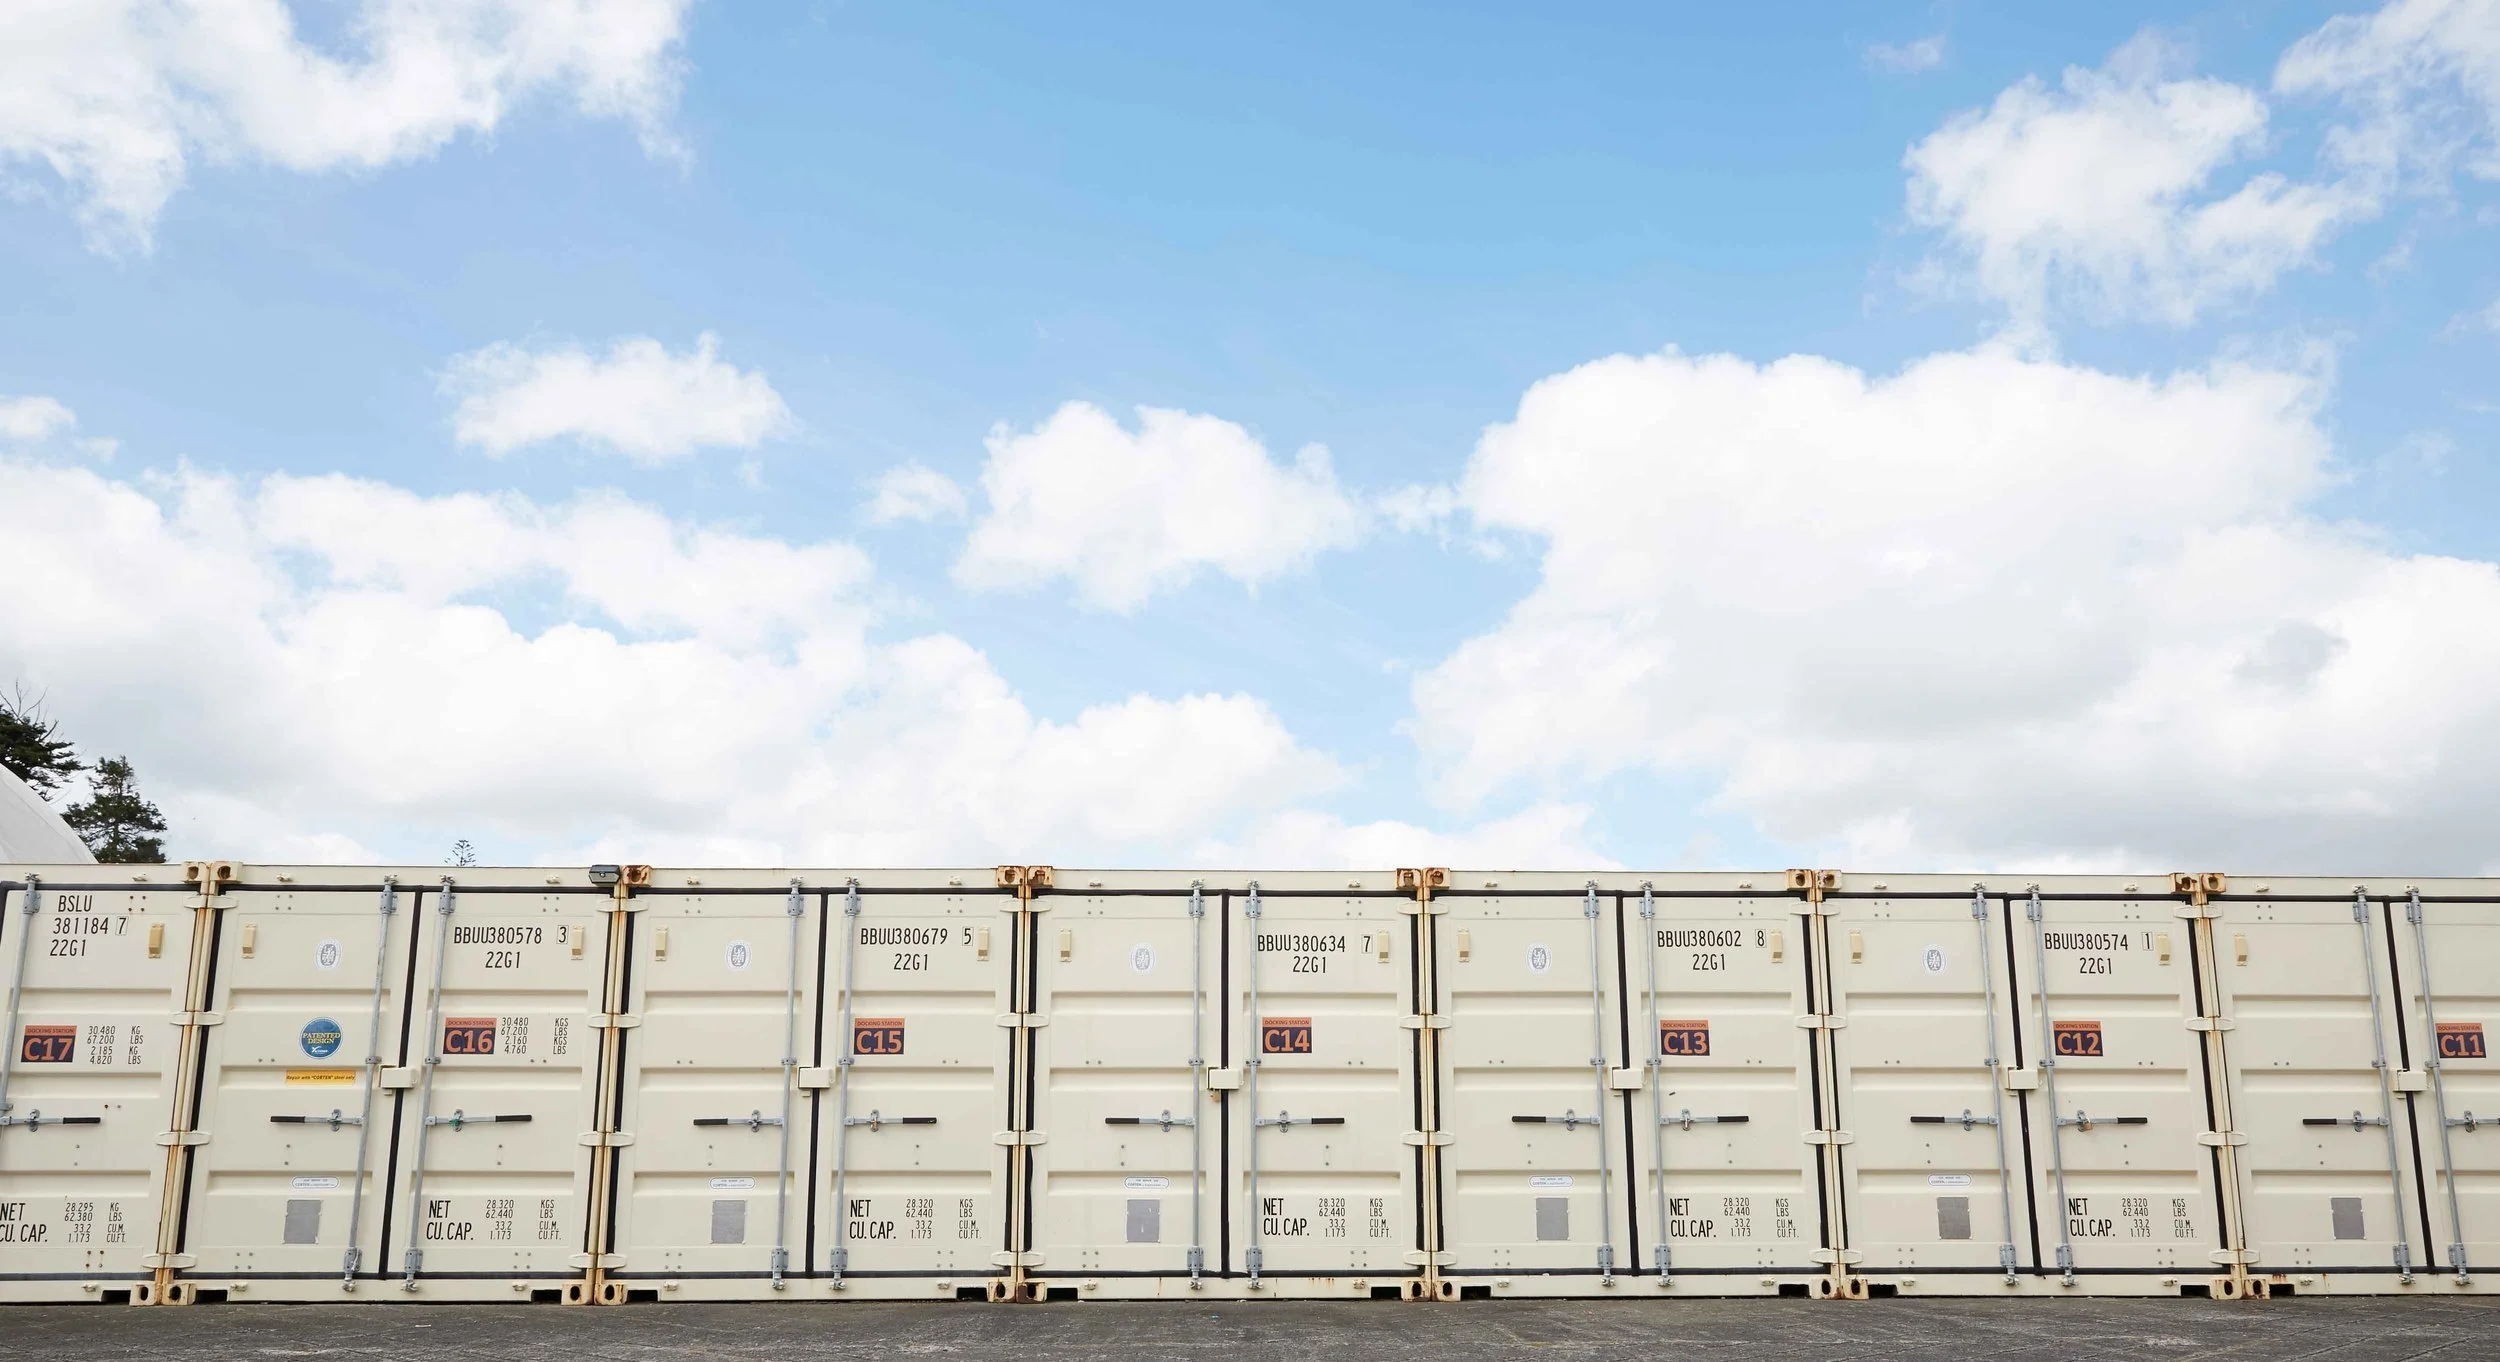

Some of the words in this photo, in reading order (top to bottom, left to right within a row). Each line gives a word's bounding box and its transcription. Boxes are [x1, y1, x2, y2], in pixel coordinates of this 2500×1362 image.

[58, 895, 92, 912] BSLU
[53, 917, 108, 934] 381184
[119, 917, 127, 934] 7
[454, 926, 542, 944] BBUU380578
[559, 927, 567, 943] 3
[860, 928, 948, 945] BBUU380679
[964, 928, 971, 944] 5
[1657, 930, 1742, 947] BBUU380602
[1757, 930, 1765, 947] 8
[50, 939, 86, 956] 22G1
[1257, 935, 1345, 952] BBUU380634
[1364, 935, 1371, 952] 7
[2044, 933, 2128, 951] BBUU380574
[2145, 933, 2150, 949] 1
[485, 951, 520, 968] 22G1
[894, 953, 928, 971] 22G1
[1293, 956, 1326, 973] 22G1
[1693, 954, 1725, 972] 22G1
[2080, 957, 2111, 974] 22G1
[502, 1017, 528, 1026] 30.480
[555, 1018, 568, 1027] KGS
[88, 1026, 115, 1035] 30.480
[131, 1026, 140, 1035] KG
[501, 1026, 528, 1035] 67.200
[554, 1027, 567, 1036] LBS
[87, 1035, 114, 1044] 67.200
[130, 1035, 143, 1044] LBS
[446, 1030, 492, 1053] C16
[505, 1036, 527, 1045] 2.160
[554, 1036, 567, 1045] KGS
[856, 1030, 902, 1053] C15
[1265, 1029, 1310, 1052] C14
[1663, 1032, 1707, 1054] C13
[2058, 1032, 2100, 1054] C12
[2440, 1034, 2483, 1056] C11
[24, 1038, 74, 1061] C17
[91, 1046, 112, 1055] 2.185
[129, 1046, 138, 1055] KG
[504, 1045, 526, 1054] 4.760
[553, 1046, 566, 1054] LBS
[90, 1056, 112, 1064] 4.820
[128, 1056, 141, 1064] LBS
[65, 1202, 93, 1212] 28.295
[110, 1202, 119, 1212] KG
[486, 1199, 514, 1209] 28.320
[541, 1199, 554, 1209] KGS
[850, 1200, 871, 1217] NET
[906, 1199, 933, 1208] 28.320
[960, 1199, 973, 1208] KGS
[1263, 1198, 1284, 1216] NET
[1319, 1198, 1345, 1207] 28.320
[1370, 1198, 1383, 1207] KGS
[1670, 1198, 1689, 1216] NET
[1724, 1197, 1749, 1206] 28.320
[1776, 1198, 1789, 1207] KGS
[2068, 1198, 2088, 1216] NET
[2122, 1198, 2147, 1208] 28.320
[2172, 1198, 2185, 1207] KGS
[0, 1203, 26, 1221] NET
[428, 1200, 451, 1218] NET
[486, 1209, 513, 1218] 62.440
[540, 1209, 553, 1218] LBS
[905, 1208, 933, 1218] 62.440
[960, 1208, 972, 1218] LBS
[1318, 1208, 1345, 1217] 62.440
[1370, 1208, 1382, 1217] LBS
[1724, 1207, 1751, 1216] 62.440
[1776, 1208, 1789, 1217] LBS
[2123, 1208, 2148, 1216] 62.440
[2173, 1208, 2186, 1217] LBS
[64, 1212, 92, 1221] 62.380
[109, 1212, 122, 1221] LBS
[1734, 1218, 1750, 1227] 33.2
[74, 1223, 91, 1233] 33.2
[495, 1221, 512, 1230] 33.2
[849, 1221, 867, 1239] CU.
[870, 1221, 896, 1239] CAP.
[916, 1220, 932, 1229] 33.2
[1263, 1218, 1281, 1236] CU.
[1284, 1218, 1309, 1236] CAP.
[1329, 1219, 1345, 1228] 33.2
[1670, 1220, 1688, 1239] CU.
[1690, 1220, 1716, 1238] CAP.
[2069, 1219, 2087, 1238] CU.
[2089, 1219, 2115, 1237] CAP.
[2133, 1219, 2150, 1228] 33.2
[20, 1224, 47, 1242] CAP.
[426, 1222, 444, 1240] CU.
[447, 1222, 473, 1240] CAP.
[490, 1231, 511, 1240] 1.173
[911, 1230, 931, 1239] 1.173
[1325, 1228, 1347, 1237] 1.173
[1731, 1228, 1751, 1237] 1.173
[2131, 1229, 2150, 1237] 1.173
[69, 1233, 90, 1243] 1.173
